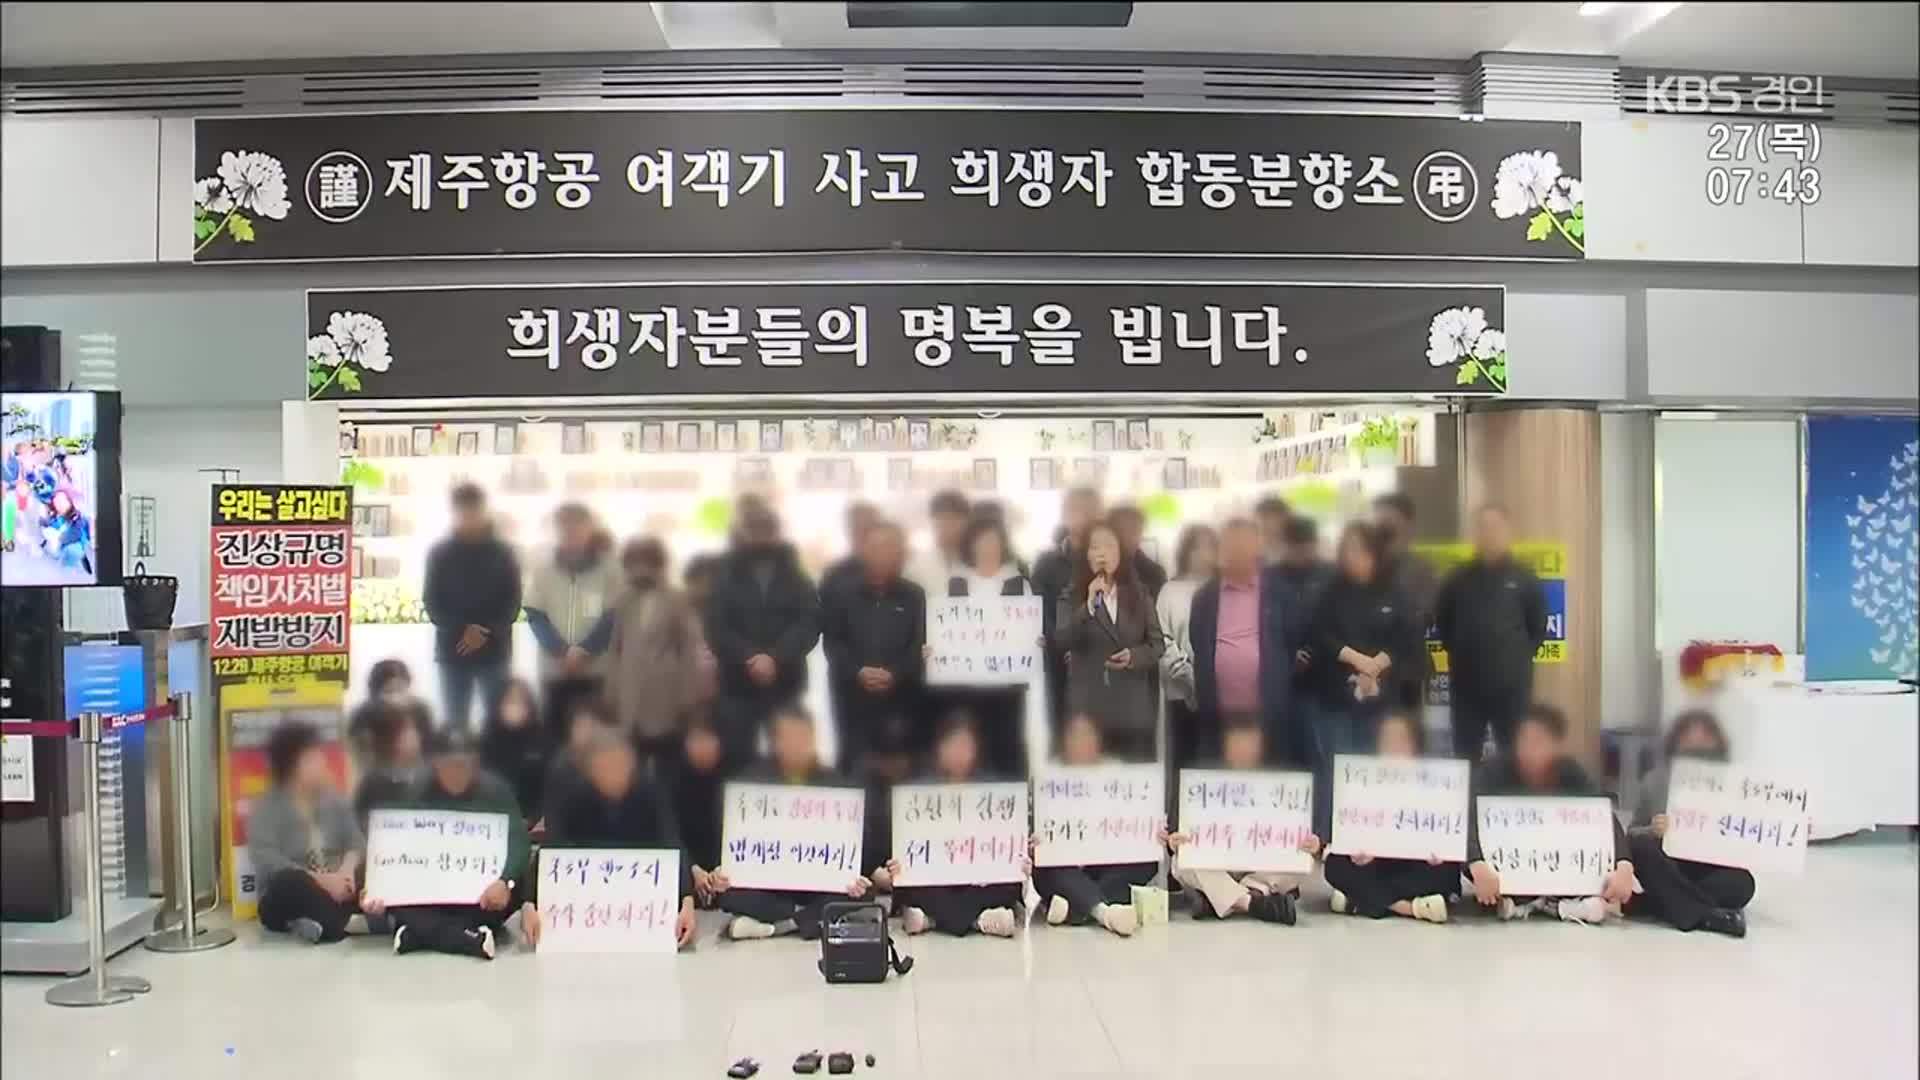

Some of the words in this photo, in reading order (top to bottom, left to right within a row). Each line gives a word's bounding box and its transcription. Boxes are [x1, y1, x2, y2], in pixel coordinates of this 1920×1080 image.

[384, 150, 601, 211] 제주항공
[626, 149, 785, 209] 여객기
[814, 149, 925, 208] 사고
[950, 149, 1115, 208] 희생자
[1135, 151, 1406, 211] 합동분향소
[506, 305, 868, 370] 희생자분들의
[899, 304, 1083, 368] 명복을
[1110, 305, 1309, 367] 빕니다.
[219, 489, 273, 521] 우리는
[276, 489, 348, 521] 살고싶다
[216, 530, 345, 568] 진상규명
[214, 572, 347, 609] 책임자처벌
[215, 613, 344, 649] 재발방지
